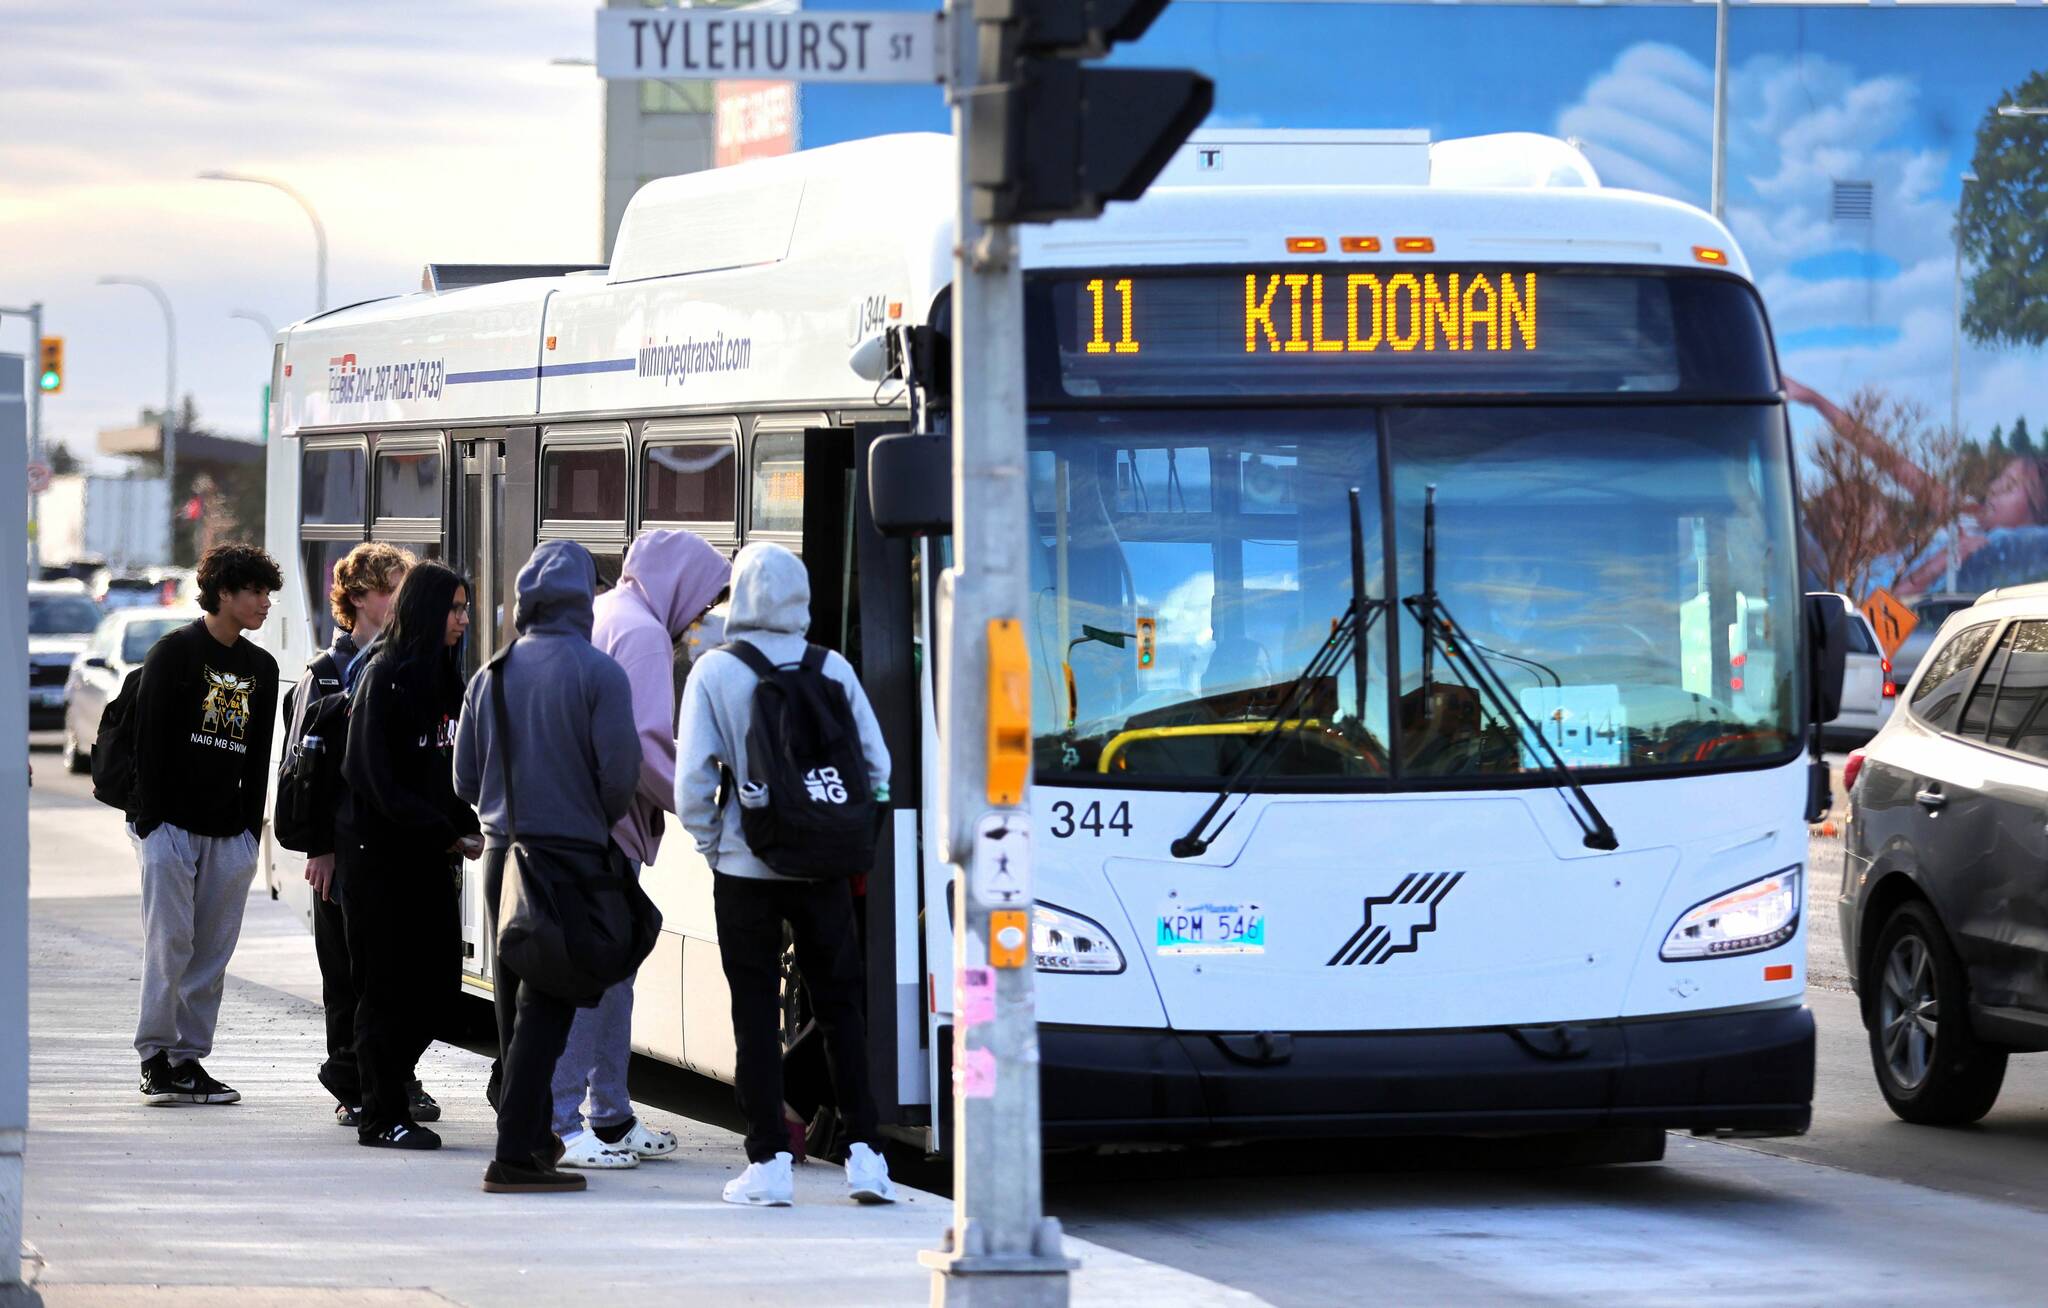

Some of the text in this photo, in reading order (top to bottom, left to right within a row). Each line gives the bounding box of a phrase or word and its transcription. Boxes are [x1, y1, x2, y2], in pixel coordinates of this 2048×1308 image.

[629, 20, 913, 71] TYLEHURST ST
[865, 295, 887, 332] 344
[1086, 273, 1537, 353] 11 KILDONAN
[639, 330, 751, 387] winnipegtransit.com
[190, 732, 213, 746] NAIG
[214, 737, 228, 750] MB
[1050, 800, 1134, 839] 344
[1162, 914, 1259, 940] KPM 546
